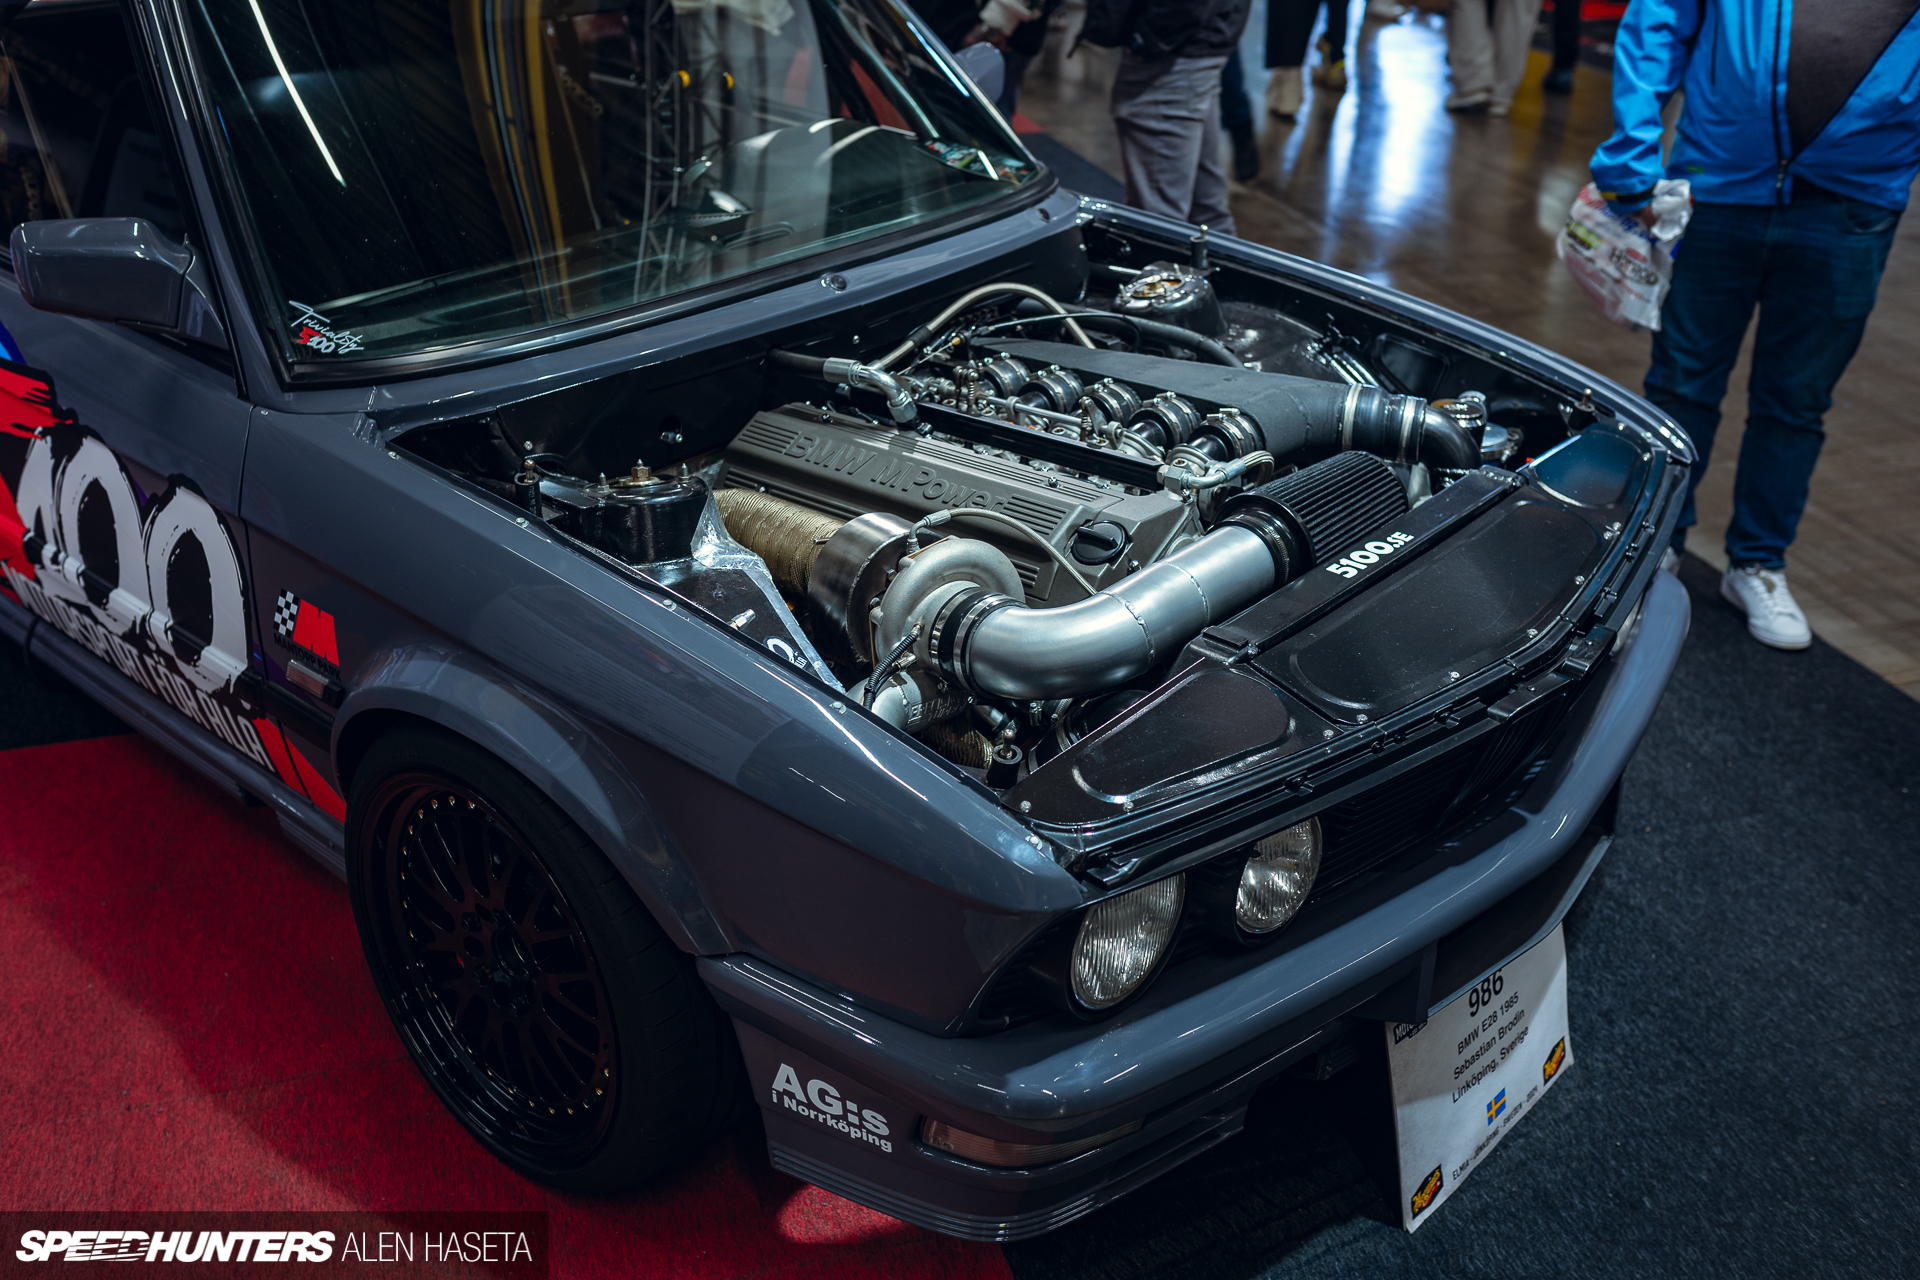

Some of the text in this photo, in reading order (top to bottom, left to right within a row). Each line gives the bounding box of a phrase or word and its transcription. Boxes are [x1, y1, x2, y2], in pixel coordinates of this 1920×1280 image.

[296, 326, 336, 353] 5100
[784, 431, 878, 476] BMW
[0, 560, 277, 773] MOTORSPORT FÖR ALLA
[273, 633, 342, 682] MANTORP PARK
[1468, 968, 1505, 1017] 986
[1395, 1023, 1416, 1040] MOT
[1453, 1033, 1497, 1080] Sebastian
[1498, 1009, 1525, 1041] Brodin
[1457, 1029, 1480, 1055] BMW
[1481, 1012, 1498, 1035] E28
[1499, 991, 1519, 1017] 1985
[1452, 1057, 1499, 1103] Linköping,
[1500, 1026, 1529, 1061] Sverige
[772, 1090, 892, 1153] i Norrköping
[1452, 1158, 1470, 1181] ELMIA
